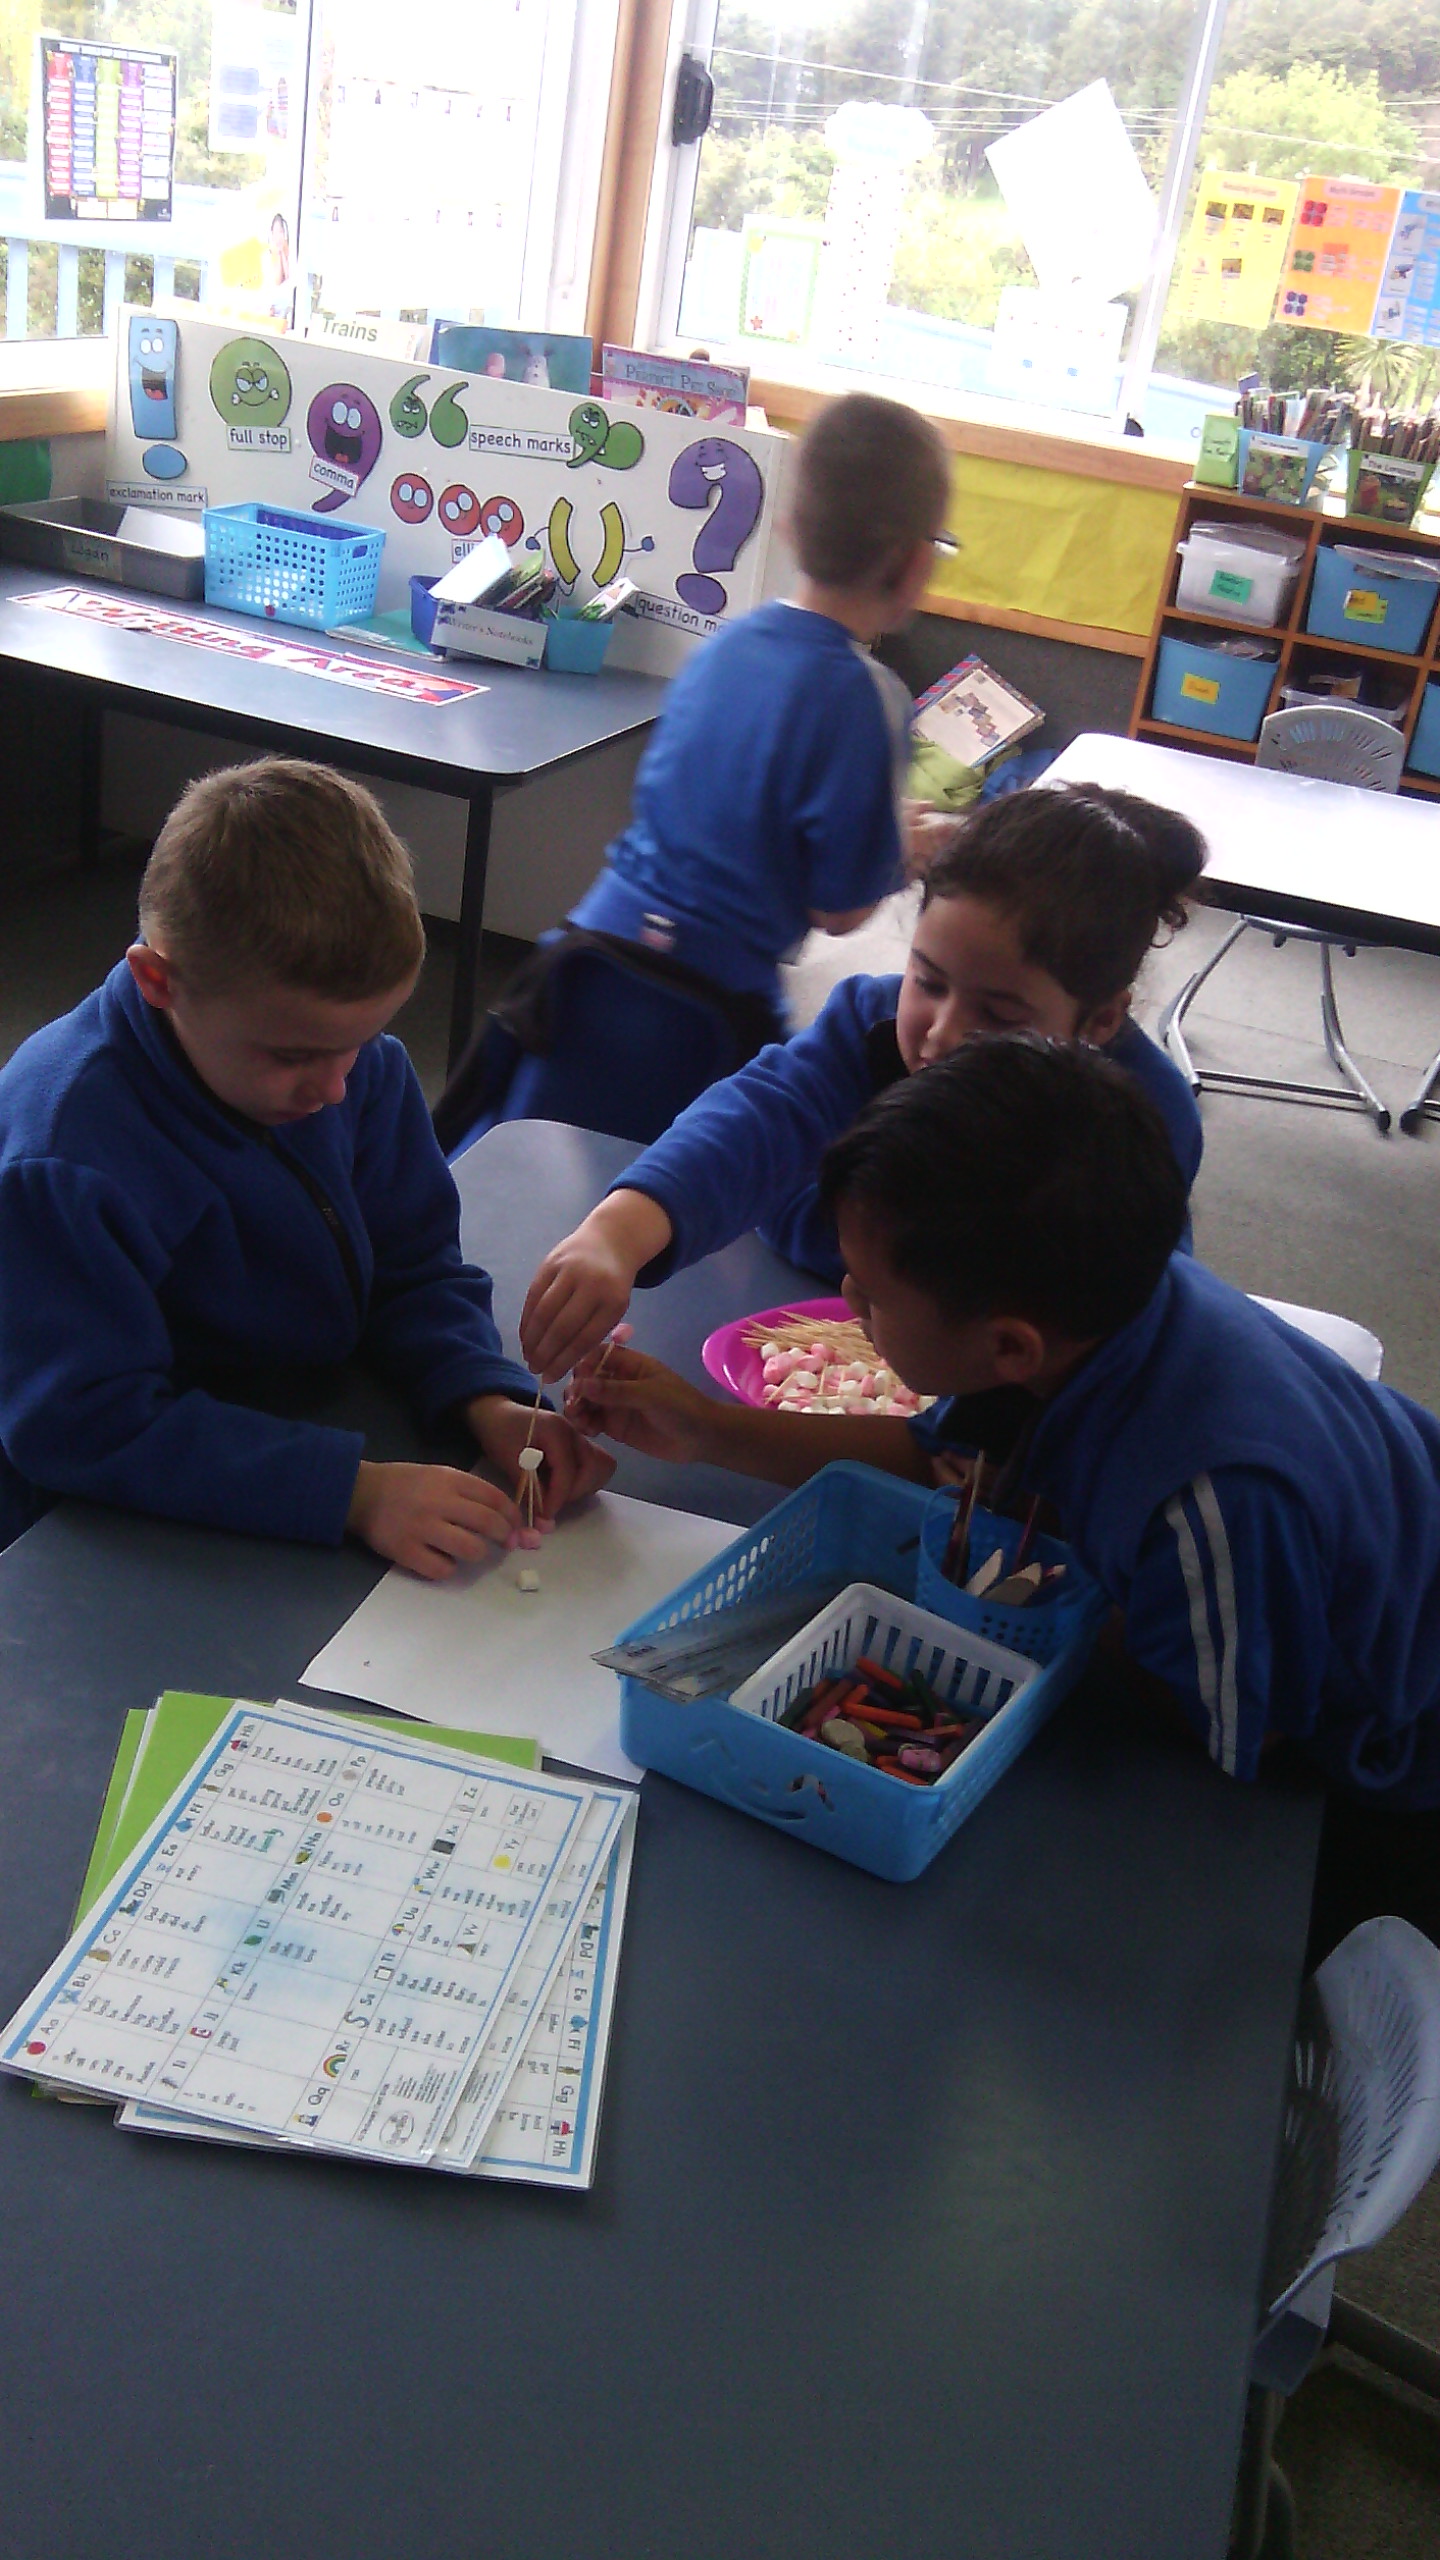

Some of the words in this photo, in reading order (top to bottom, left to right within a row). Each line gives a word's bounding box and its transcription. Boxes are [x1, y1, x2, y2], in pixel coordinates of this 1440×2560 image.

[322, 318, 378, 342] Trains
[230, 428, 252, 444] full
[259, 429, 287, 449] stop
[471, 432, 521, 448] speech
[527, 437, 571, 453] marks
[313, 463, 354, 489] comma
[109, 486, 173, 500] exclamation
[177, 492, 205, 503] mark
[637, 598, 699, 626] question
[80, 599, 276, 658] Writing
[349, 1754, 368, 1767] Pp
[188, 1802, 204, 1814] Ff
[326, 1790, 345, 1807] Oo
[421, 1859, 442, 1880] Ww
[132, 1880, 153, 1898] Dd
[401, 1905, 419, 1921] Uu
[462, 1922, 479, 1937] Vv
[578, 1941, 593, 1959] Dd
[71, 1971, 92, 1988] Bb
[38, 2017, 61, 2036] Aa
[305, 2085, 330, 2107] Qq
[555, 2083, 574, 2104] Gg
[551, 2139, 565, 2158] Hh
